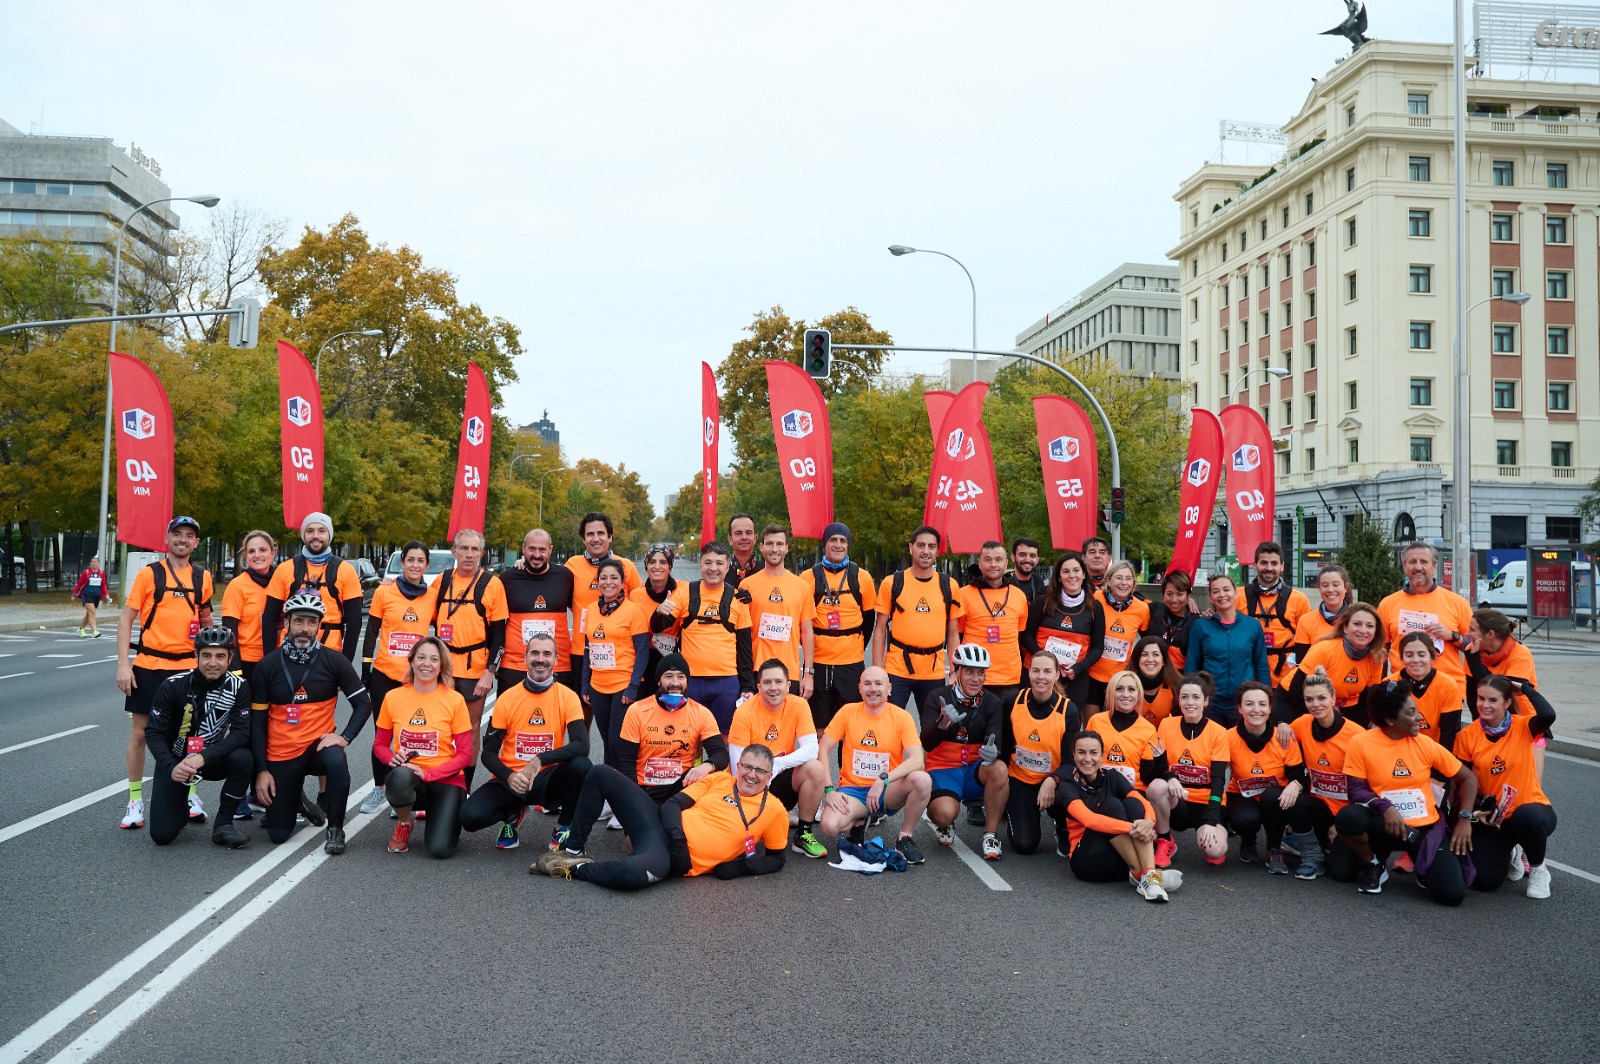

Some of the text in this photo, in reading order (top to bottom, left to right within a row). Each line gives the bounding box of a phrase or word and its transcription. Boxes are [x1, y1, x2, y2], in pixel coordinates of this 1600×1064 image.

[1536, 19, 1600, 49] Gra
[766, 625, 785, 633] 5887
[522, 745, 546, 754] 10363
[860, 762, 880, 771] 6491
